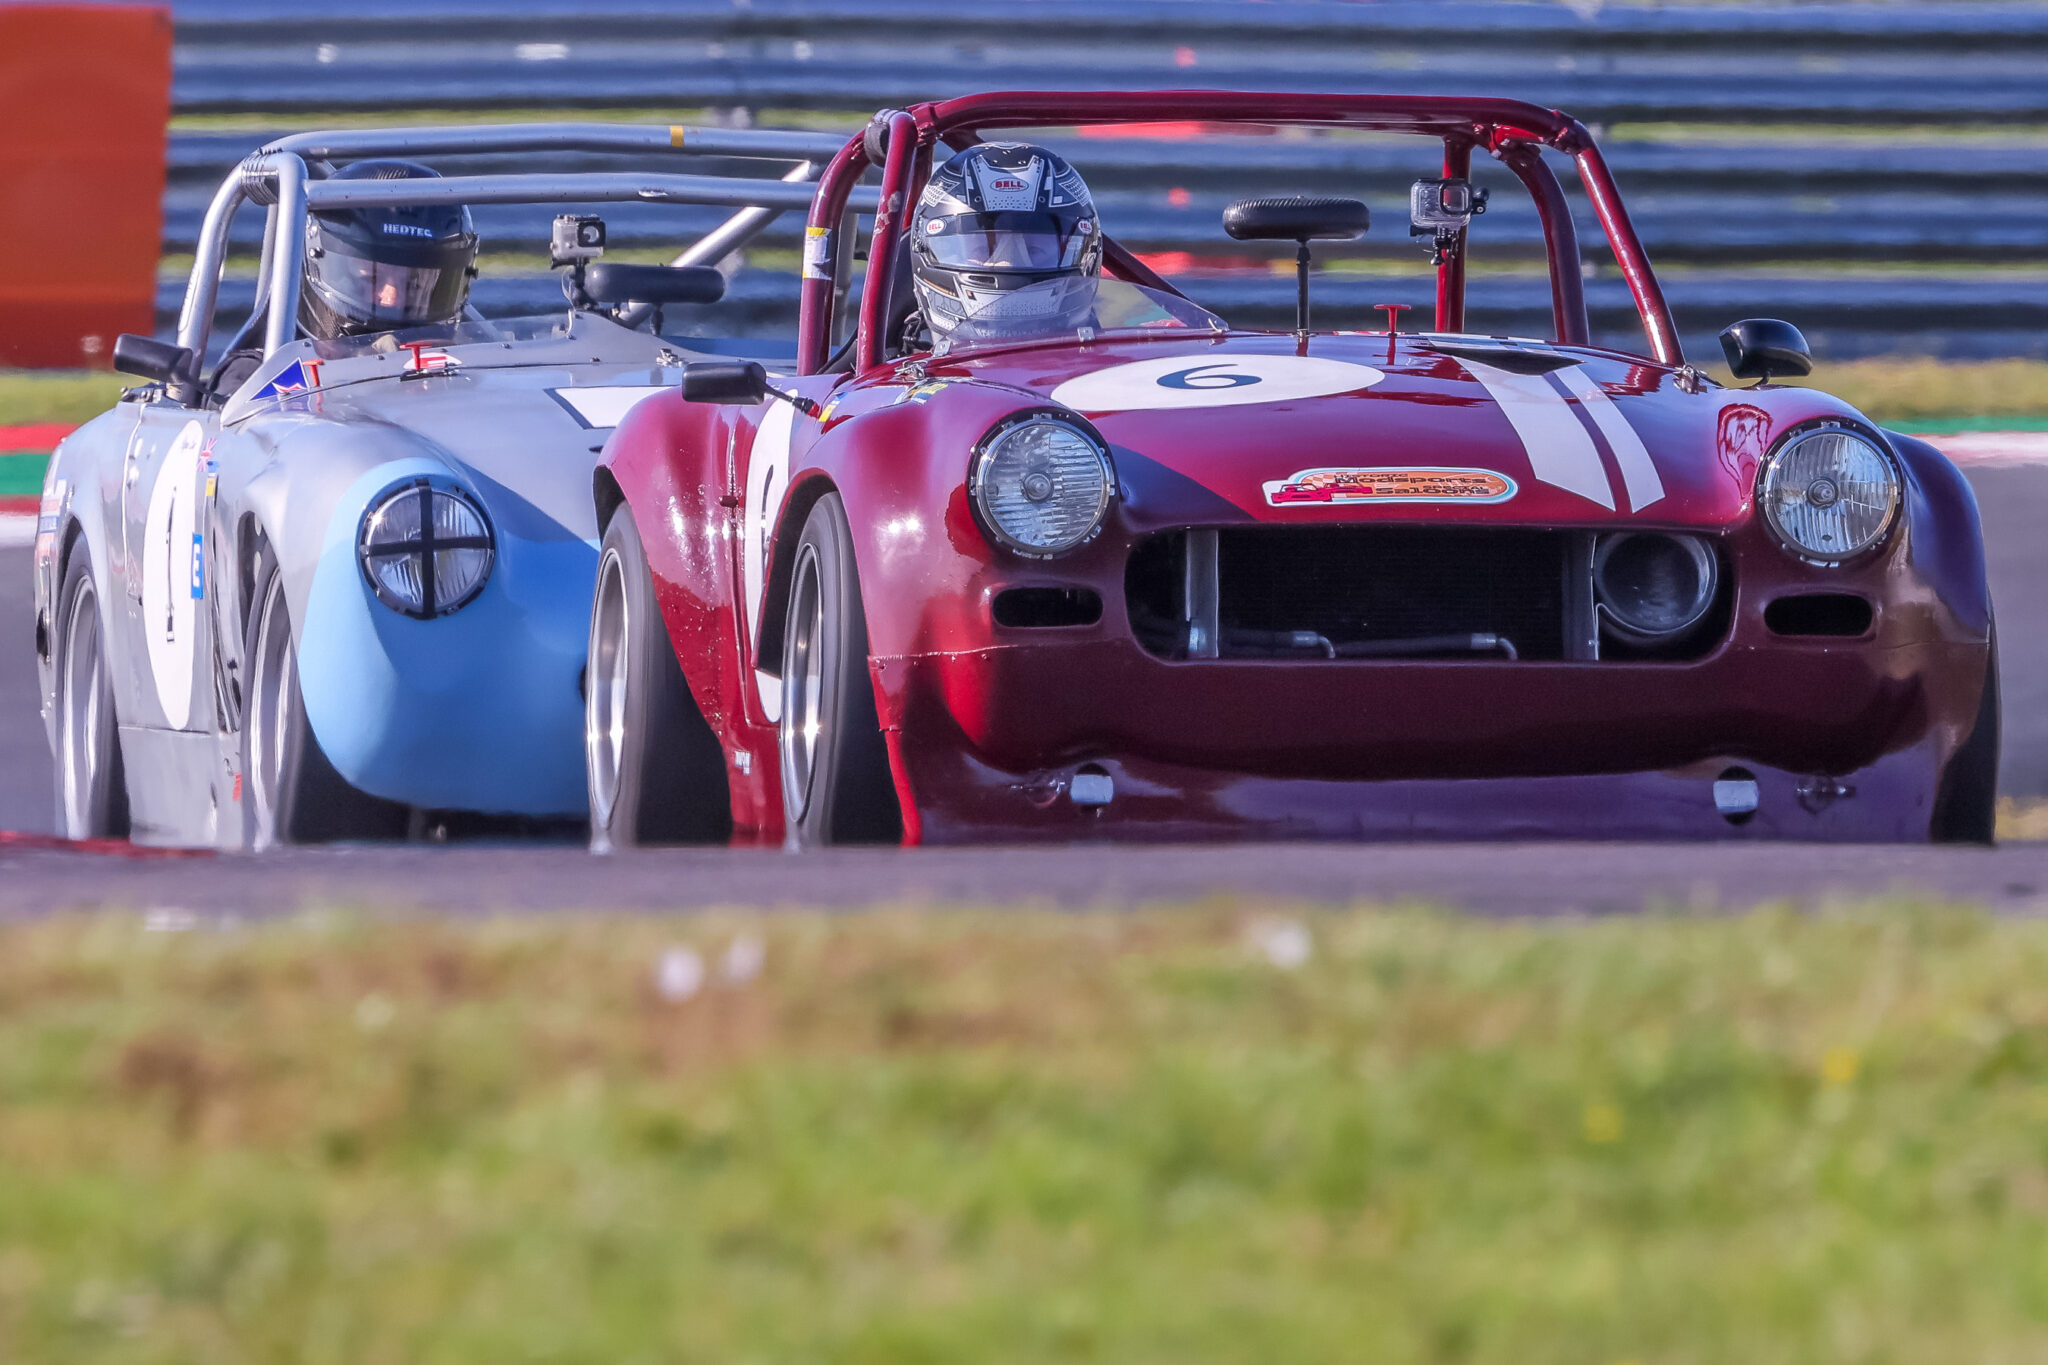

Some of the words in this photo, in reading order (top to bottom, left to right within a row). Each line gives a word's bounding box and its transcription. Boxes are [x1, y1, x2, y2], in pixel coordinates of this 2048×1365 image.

[383, 223, 433, 238] HEDTEC
[928, 223, 942, 231] BELL
[1156, 363, 1262, 389] 6
[1335, 475, 1487, 484] Modsports
[1375, 486, 1490, 495] Saloons
